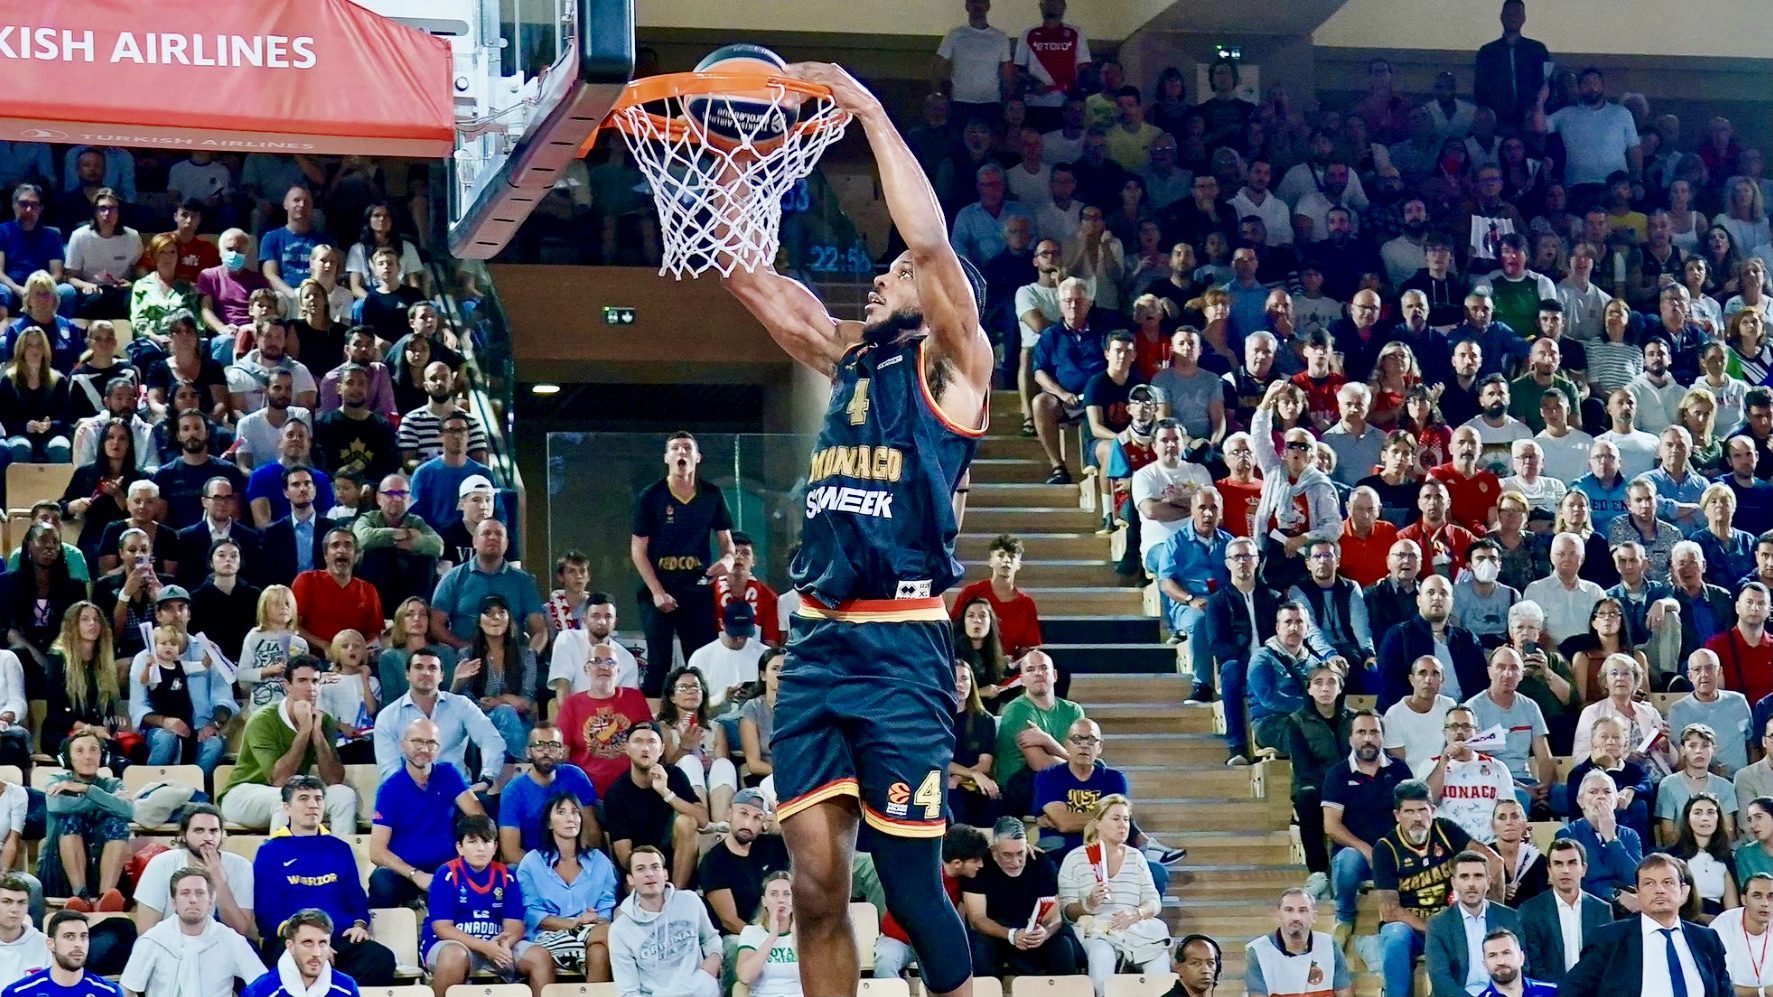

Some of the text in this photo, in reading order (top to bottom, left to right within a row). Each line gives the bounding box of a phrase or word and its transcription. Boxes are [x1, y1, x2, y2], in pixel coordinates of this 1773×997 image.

[109, 31, 317, 69] AIRLINES
[80, 133, 315, 150] TURKISH AIRLINES
[846, 377, 871, 426] 4
[808, 444, 903, 485] MONACO
[914, 770, 942, 819] 4
